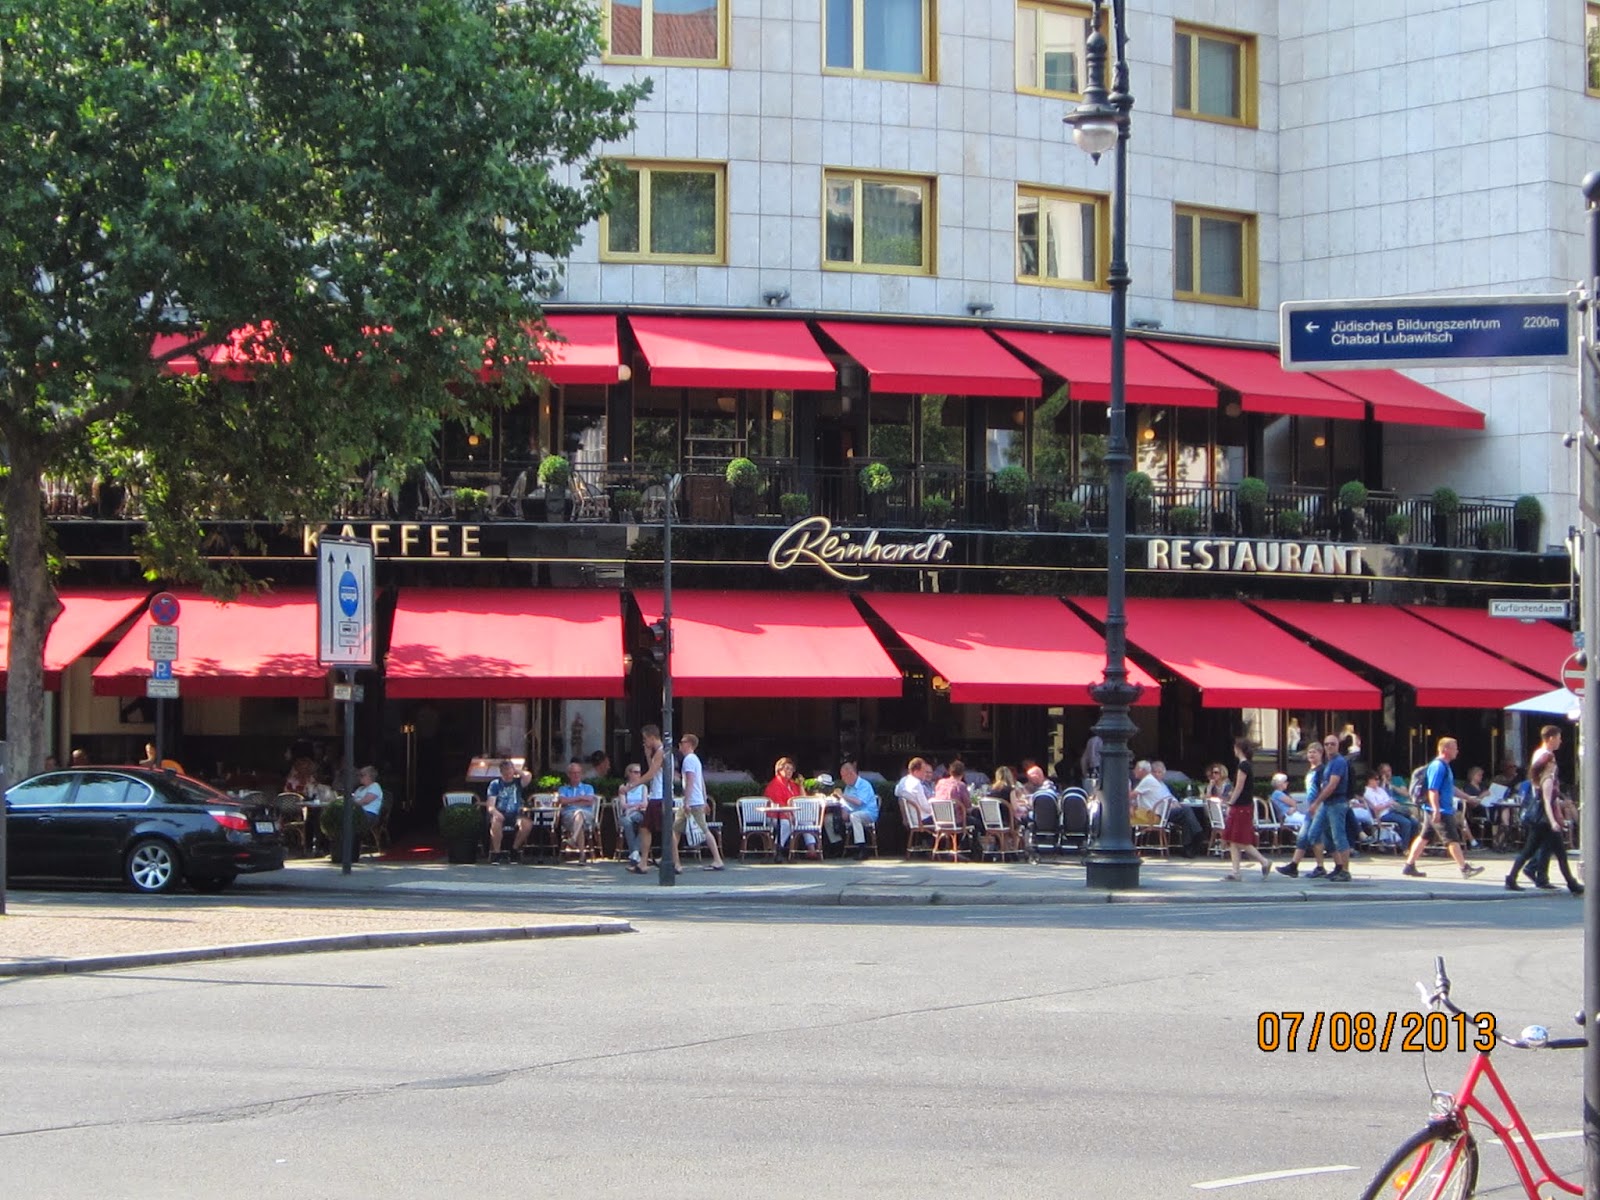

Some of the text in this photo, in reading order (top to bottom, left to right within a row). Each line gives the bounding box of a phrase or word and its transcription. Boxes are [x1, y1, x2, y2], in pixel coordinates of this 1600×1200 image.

[1331, 316, 1559, 333] Jüdisches Bildungszentrum 2200m
[1331, 332, 1453, 346] Chabad Lubawitsch
[768, 515, 954, 581] Reinhard's
[1147, 538, 1367, 575] RESTAURANT
[1494, 603, 1563, 613] Kurfürstendamm
